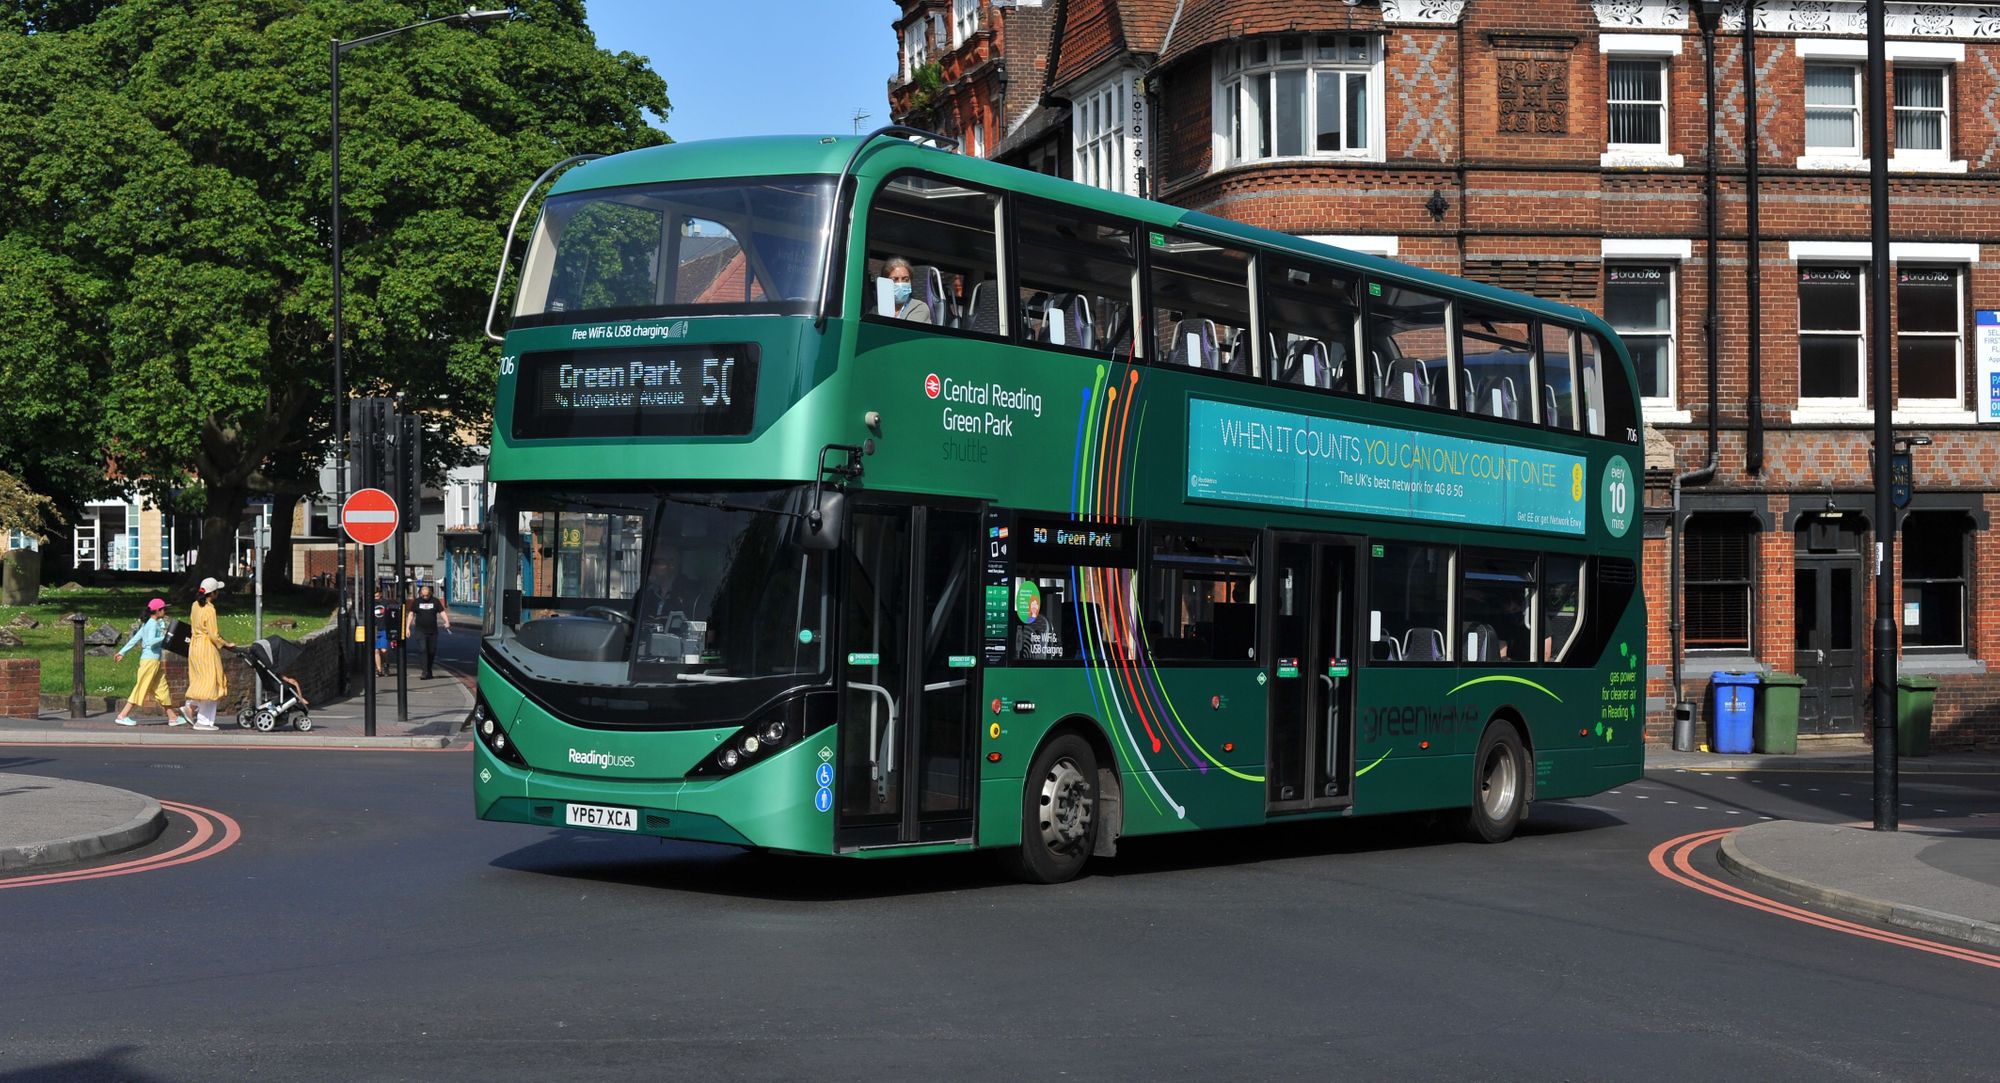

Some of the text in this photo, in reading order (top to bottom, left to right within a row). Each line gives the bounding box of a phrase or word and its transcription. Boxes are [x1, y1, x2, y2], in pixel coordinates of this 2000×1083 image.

[572, 324, 669, 340] free WiFi & USB charging
[560, 364, 624, 388] Green
[630, 360, 682, 385] Park
[573, 392, 634, 408] Longwater
[640, 390, 684, 405] Avenue
[943, 377, 1042, 418] Central Reading
[943, 407, 1013, 437] Green Park
[1626, 427, 1638, 443] 706
[942, 437, 988, 463] shuttle
[1220, 418, 1556, 488] WHEN IT COUNTS, YOU CAN ONLY COUNT ON EE
[1339, 470, 1464, 498] The UK's best network for 4G & 5G
[1611, 467, 1625, 483] every
[1609, 481, 1626, 514] 10
[1517, 511, 1527, 522] Get
[1540, 515, 1549, 526] get
[1549, 515, 1570, 526] Network
[1570, 517, 1582, 529] Envy
[1611, 518, 1625, 530] mins
[1033, 527, 1112, 547] 50 Green Park
[1030, 632, 1058, 643] free WiFi &
[1030, 644, 1064, 657] USB charging
[1610, 671, 1637, 686] gas power
[1602, 686, 1637, 700] for cleaner air
[1602, 704, 1629, 721] in Reading
[1363, 704, 1480, 743] greenwave
[568, 748, 636, 769] Readingbuses
[572, 806, 631, 827] YP67 XCA
